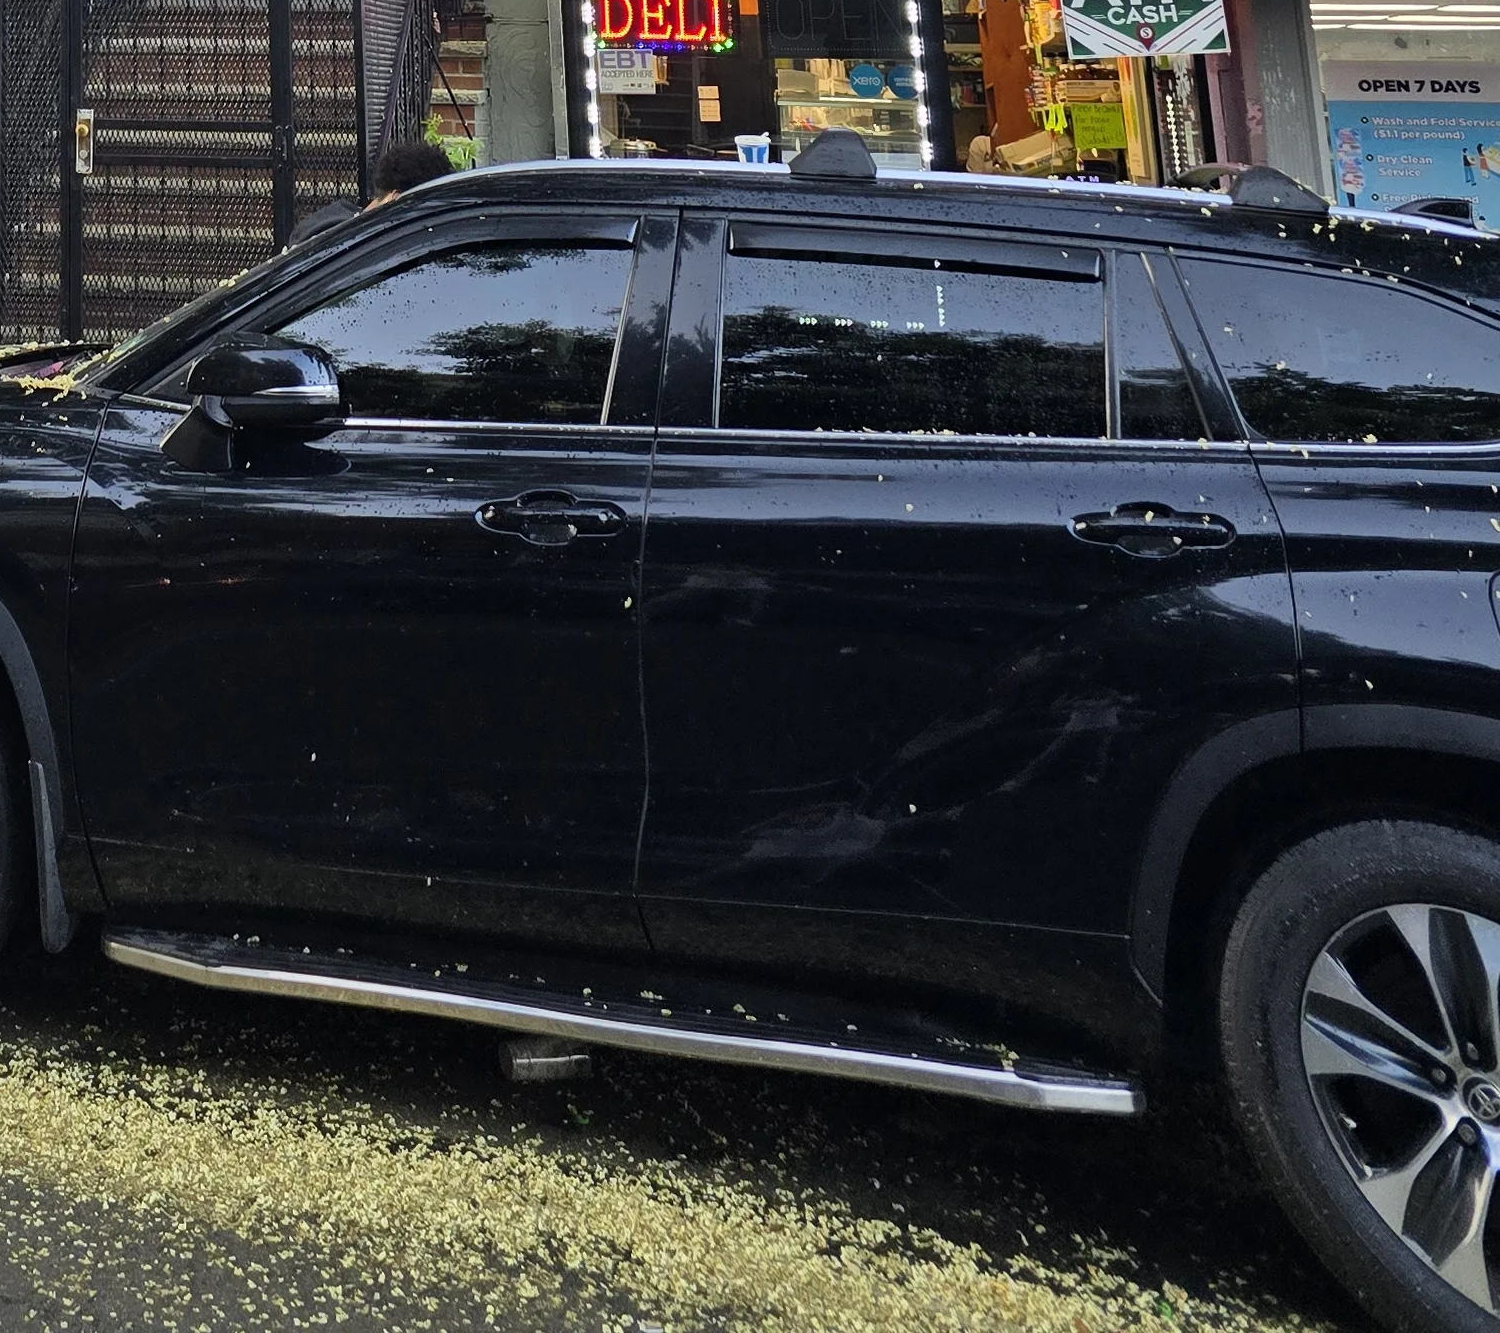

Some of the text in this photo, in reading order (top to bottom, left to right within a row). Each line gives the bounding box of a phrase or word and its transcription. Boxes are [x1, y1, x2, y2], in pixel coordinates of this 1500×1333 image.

[1107, 4, 1178, 26] CASH
[600, 50, 652, 69] EBT
[601, 70, 655, 79] ACCEPTED HERE
[1358, 79, 1482, 94] OPEN 7 DAYS
[1372, 116, 1404, 127] Wash
[1406, 116, 1428, 127] and
[1431, 117, 1456, 127] Fold
[1401, 131, 1420, 141] per
[1423, 130, 1466, 141] pound)
[1377, 155, 1433, 165] Dry Clean
[1379, 168, 1422, 177] Service
